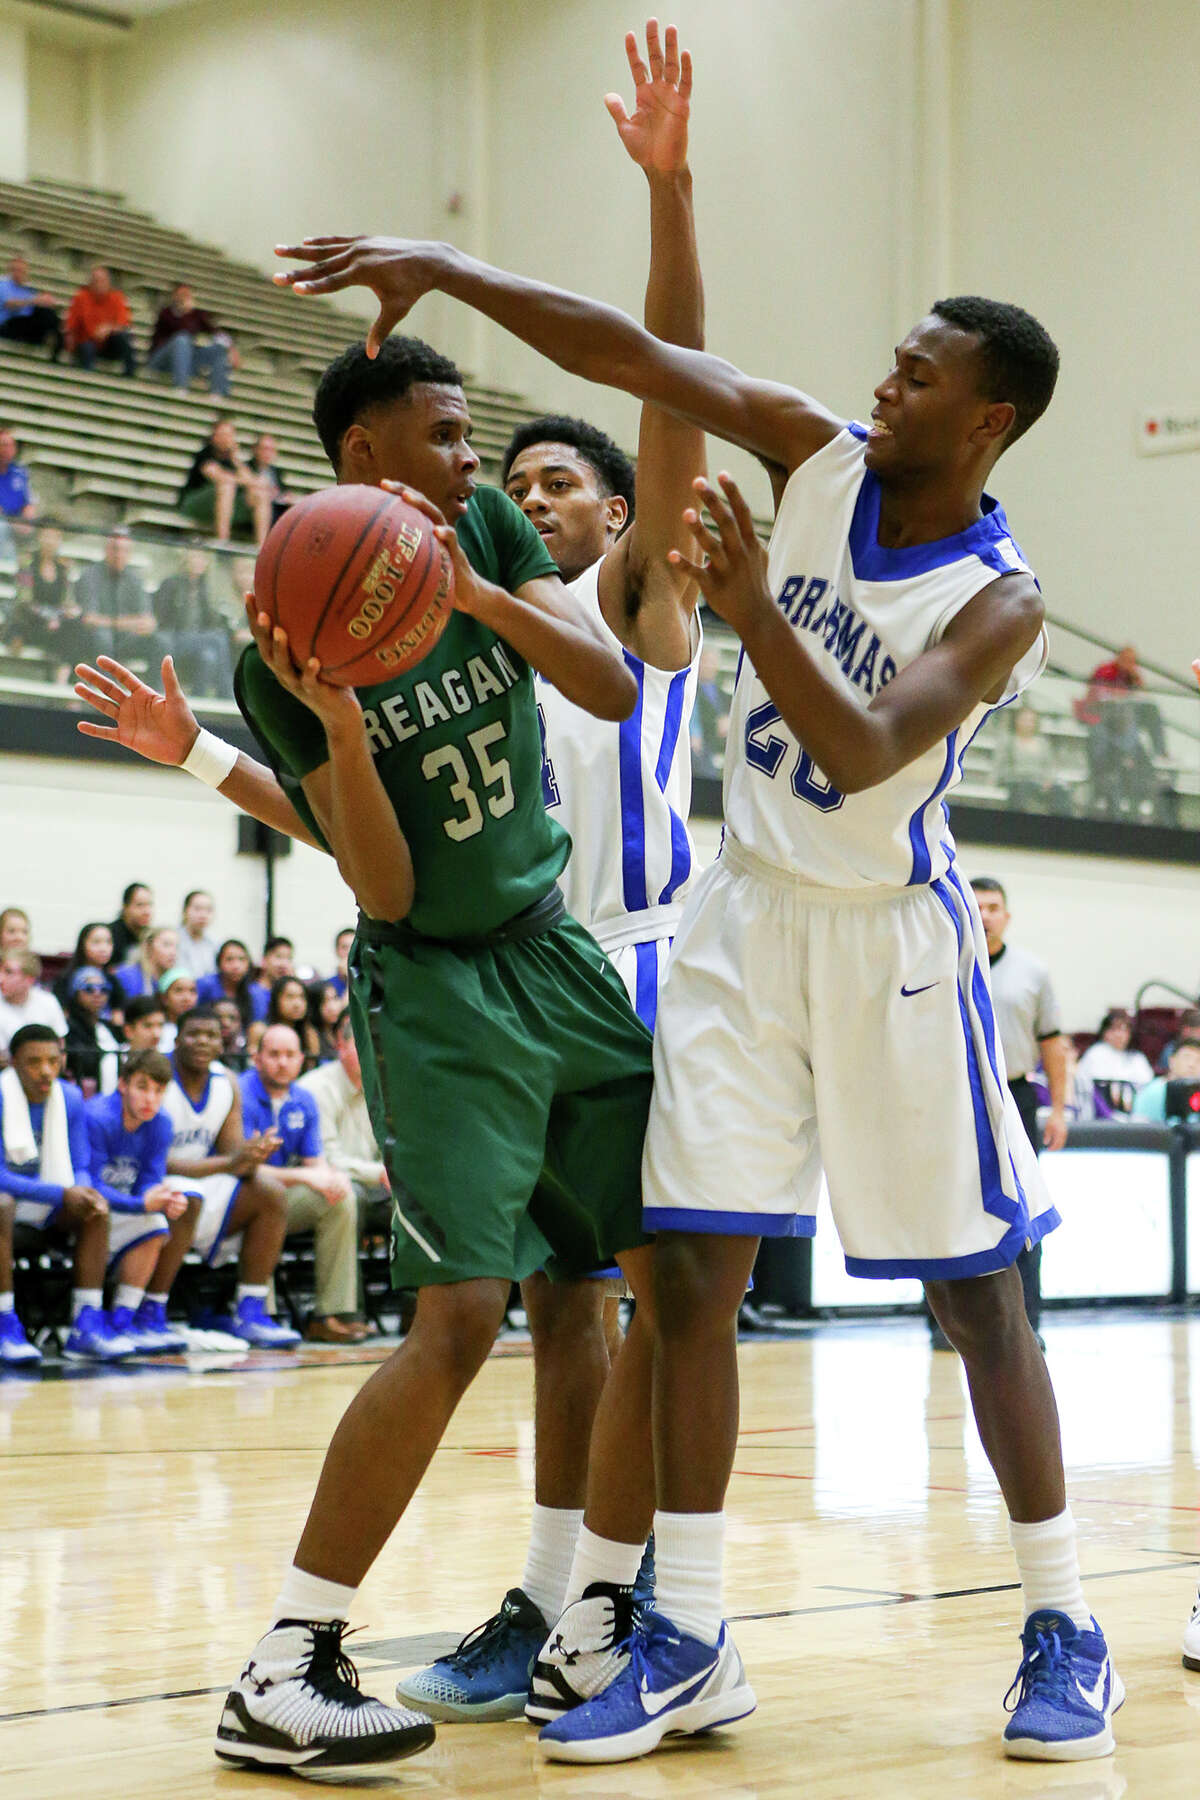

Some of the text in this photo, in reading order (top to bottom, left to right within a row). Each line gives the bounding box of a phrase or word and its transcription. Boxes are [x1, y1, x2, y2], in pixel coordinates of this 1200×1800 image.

[347, 522, 422, 640] TF-1000
[362, 641, 519, 755] REAGAN
[421, 720, 515, 842] 35
